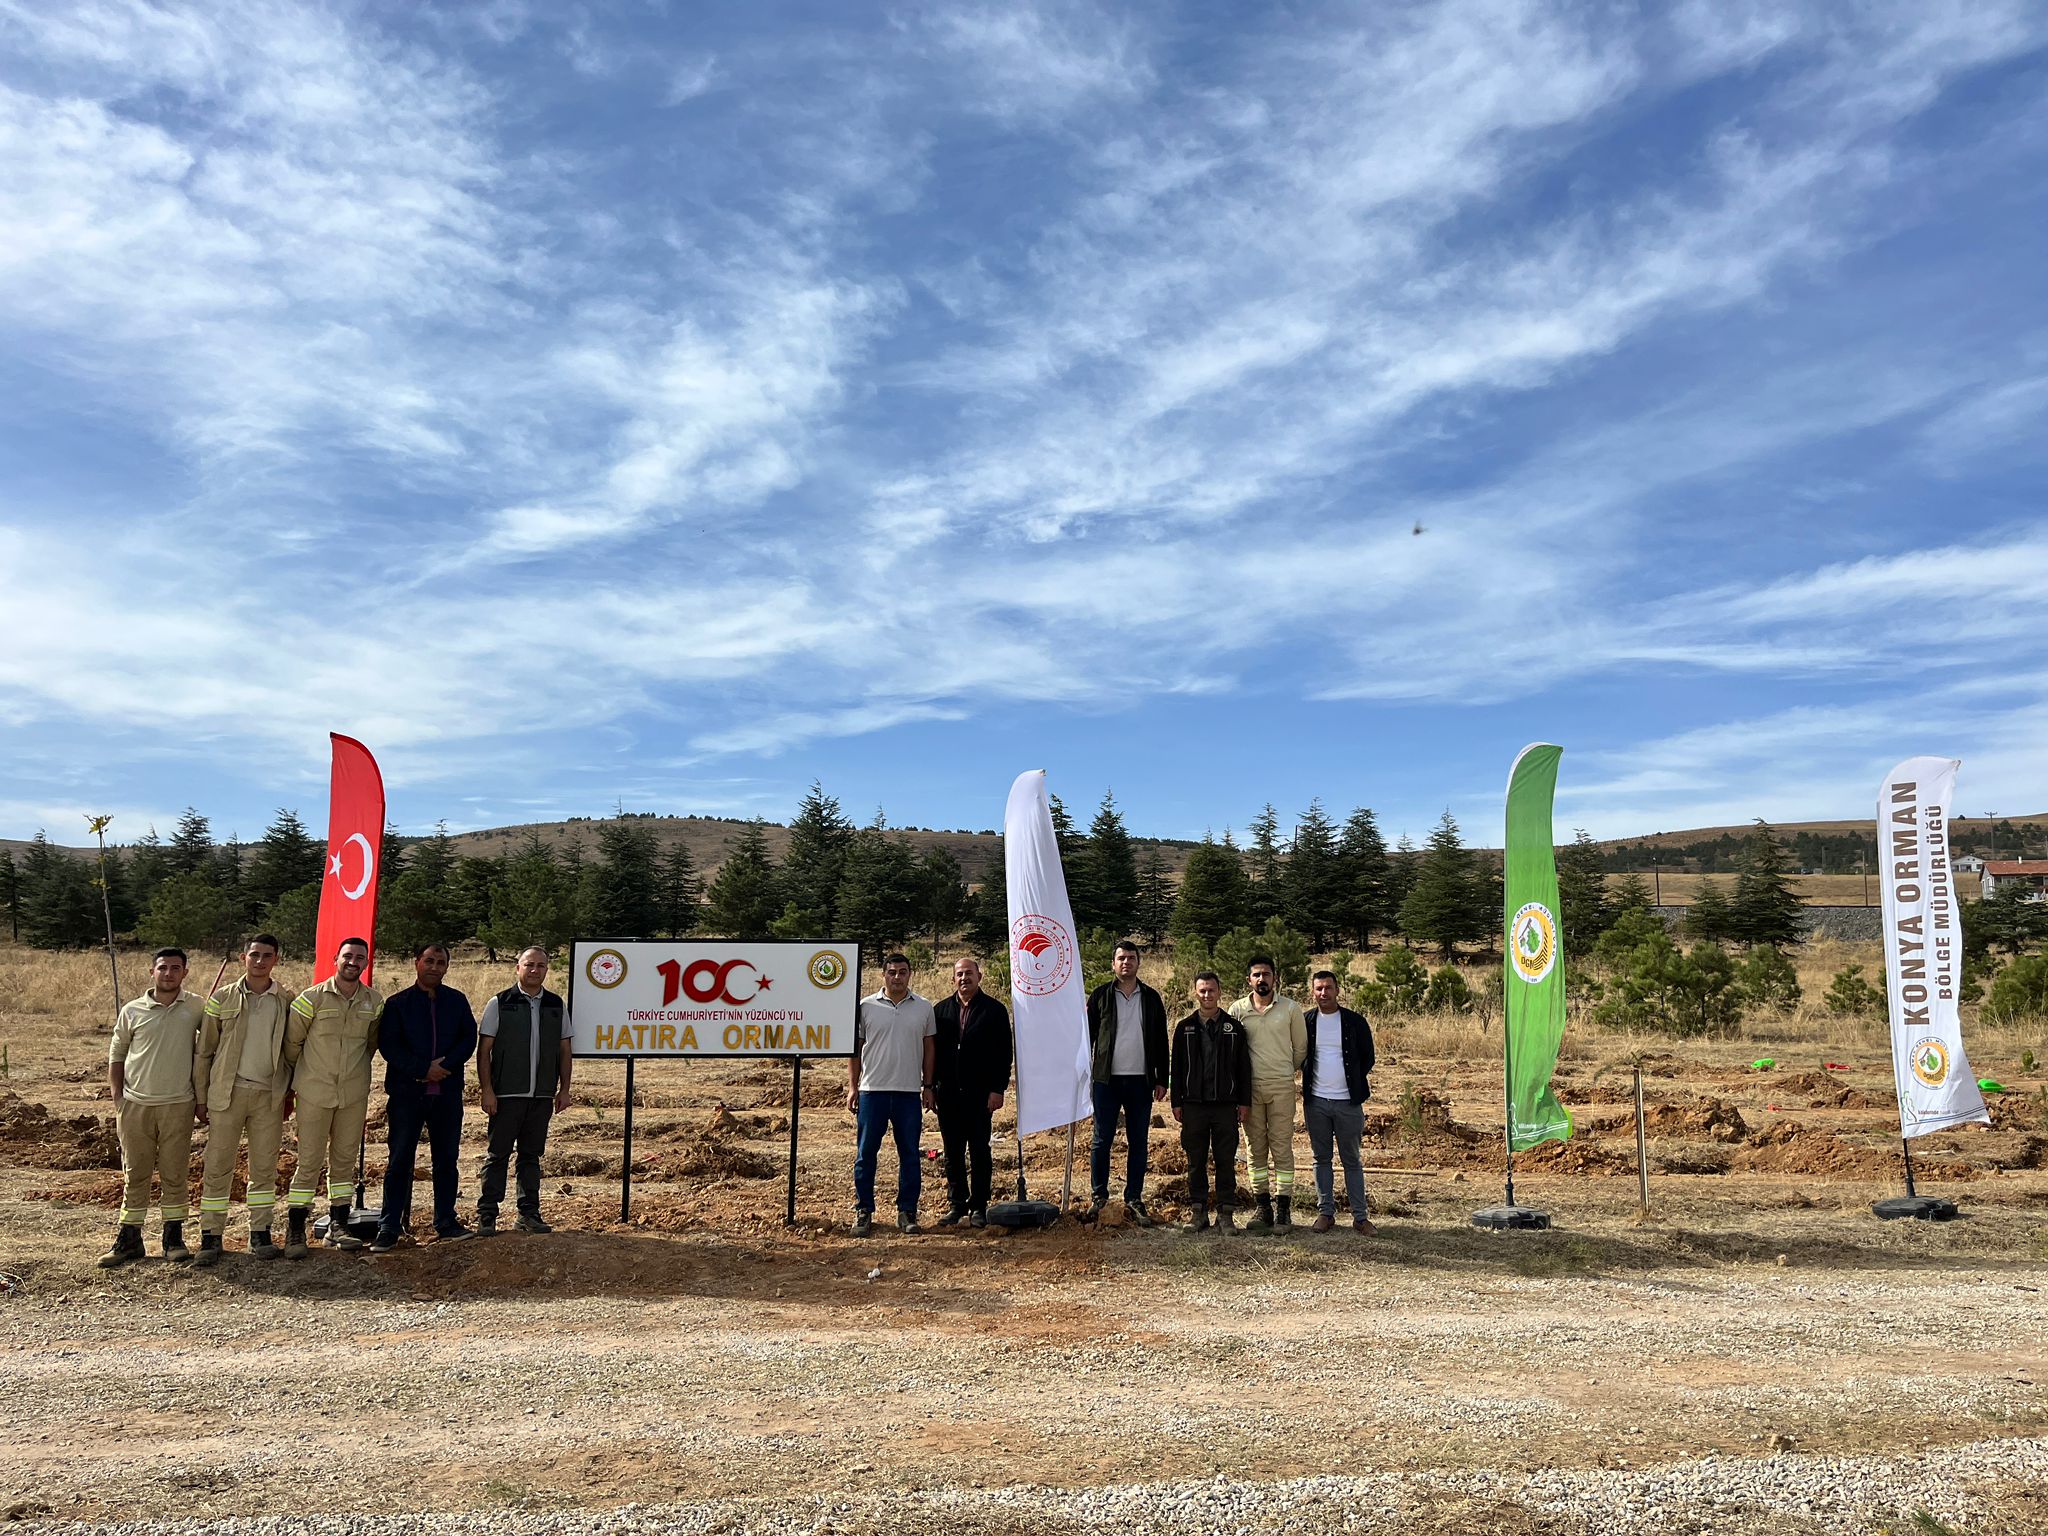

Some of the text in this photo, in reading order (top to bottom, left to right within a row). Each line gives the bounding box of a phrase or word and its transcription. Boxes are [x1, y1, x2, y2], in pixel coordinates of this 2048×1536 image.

[1891, 782, 1921, 903] ORMAN
[1925, 805, 1953, 999] BÖLGE MÜDÜRLÜĞÜ
[627, 1009, 803, 1020] TÜRKİYE CUMHURİYETİ'NİN YÜZÜNCÜ YILI
[1898, 915, 1930, 1025] KONYA
[595, 1024, 831, 1050] HATIRA ORMANI
